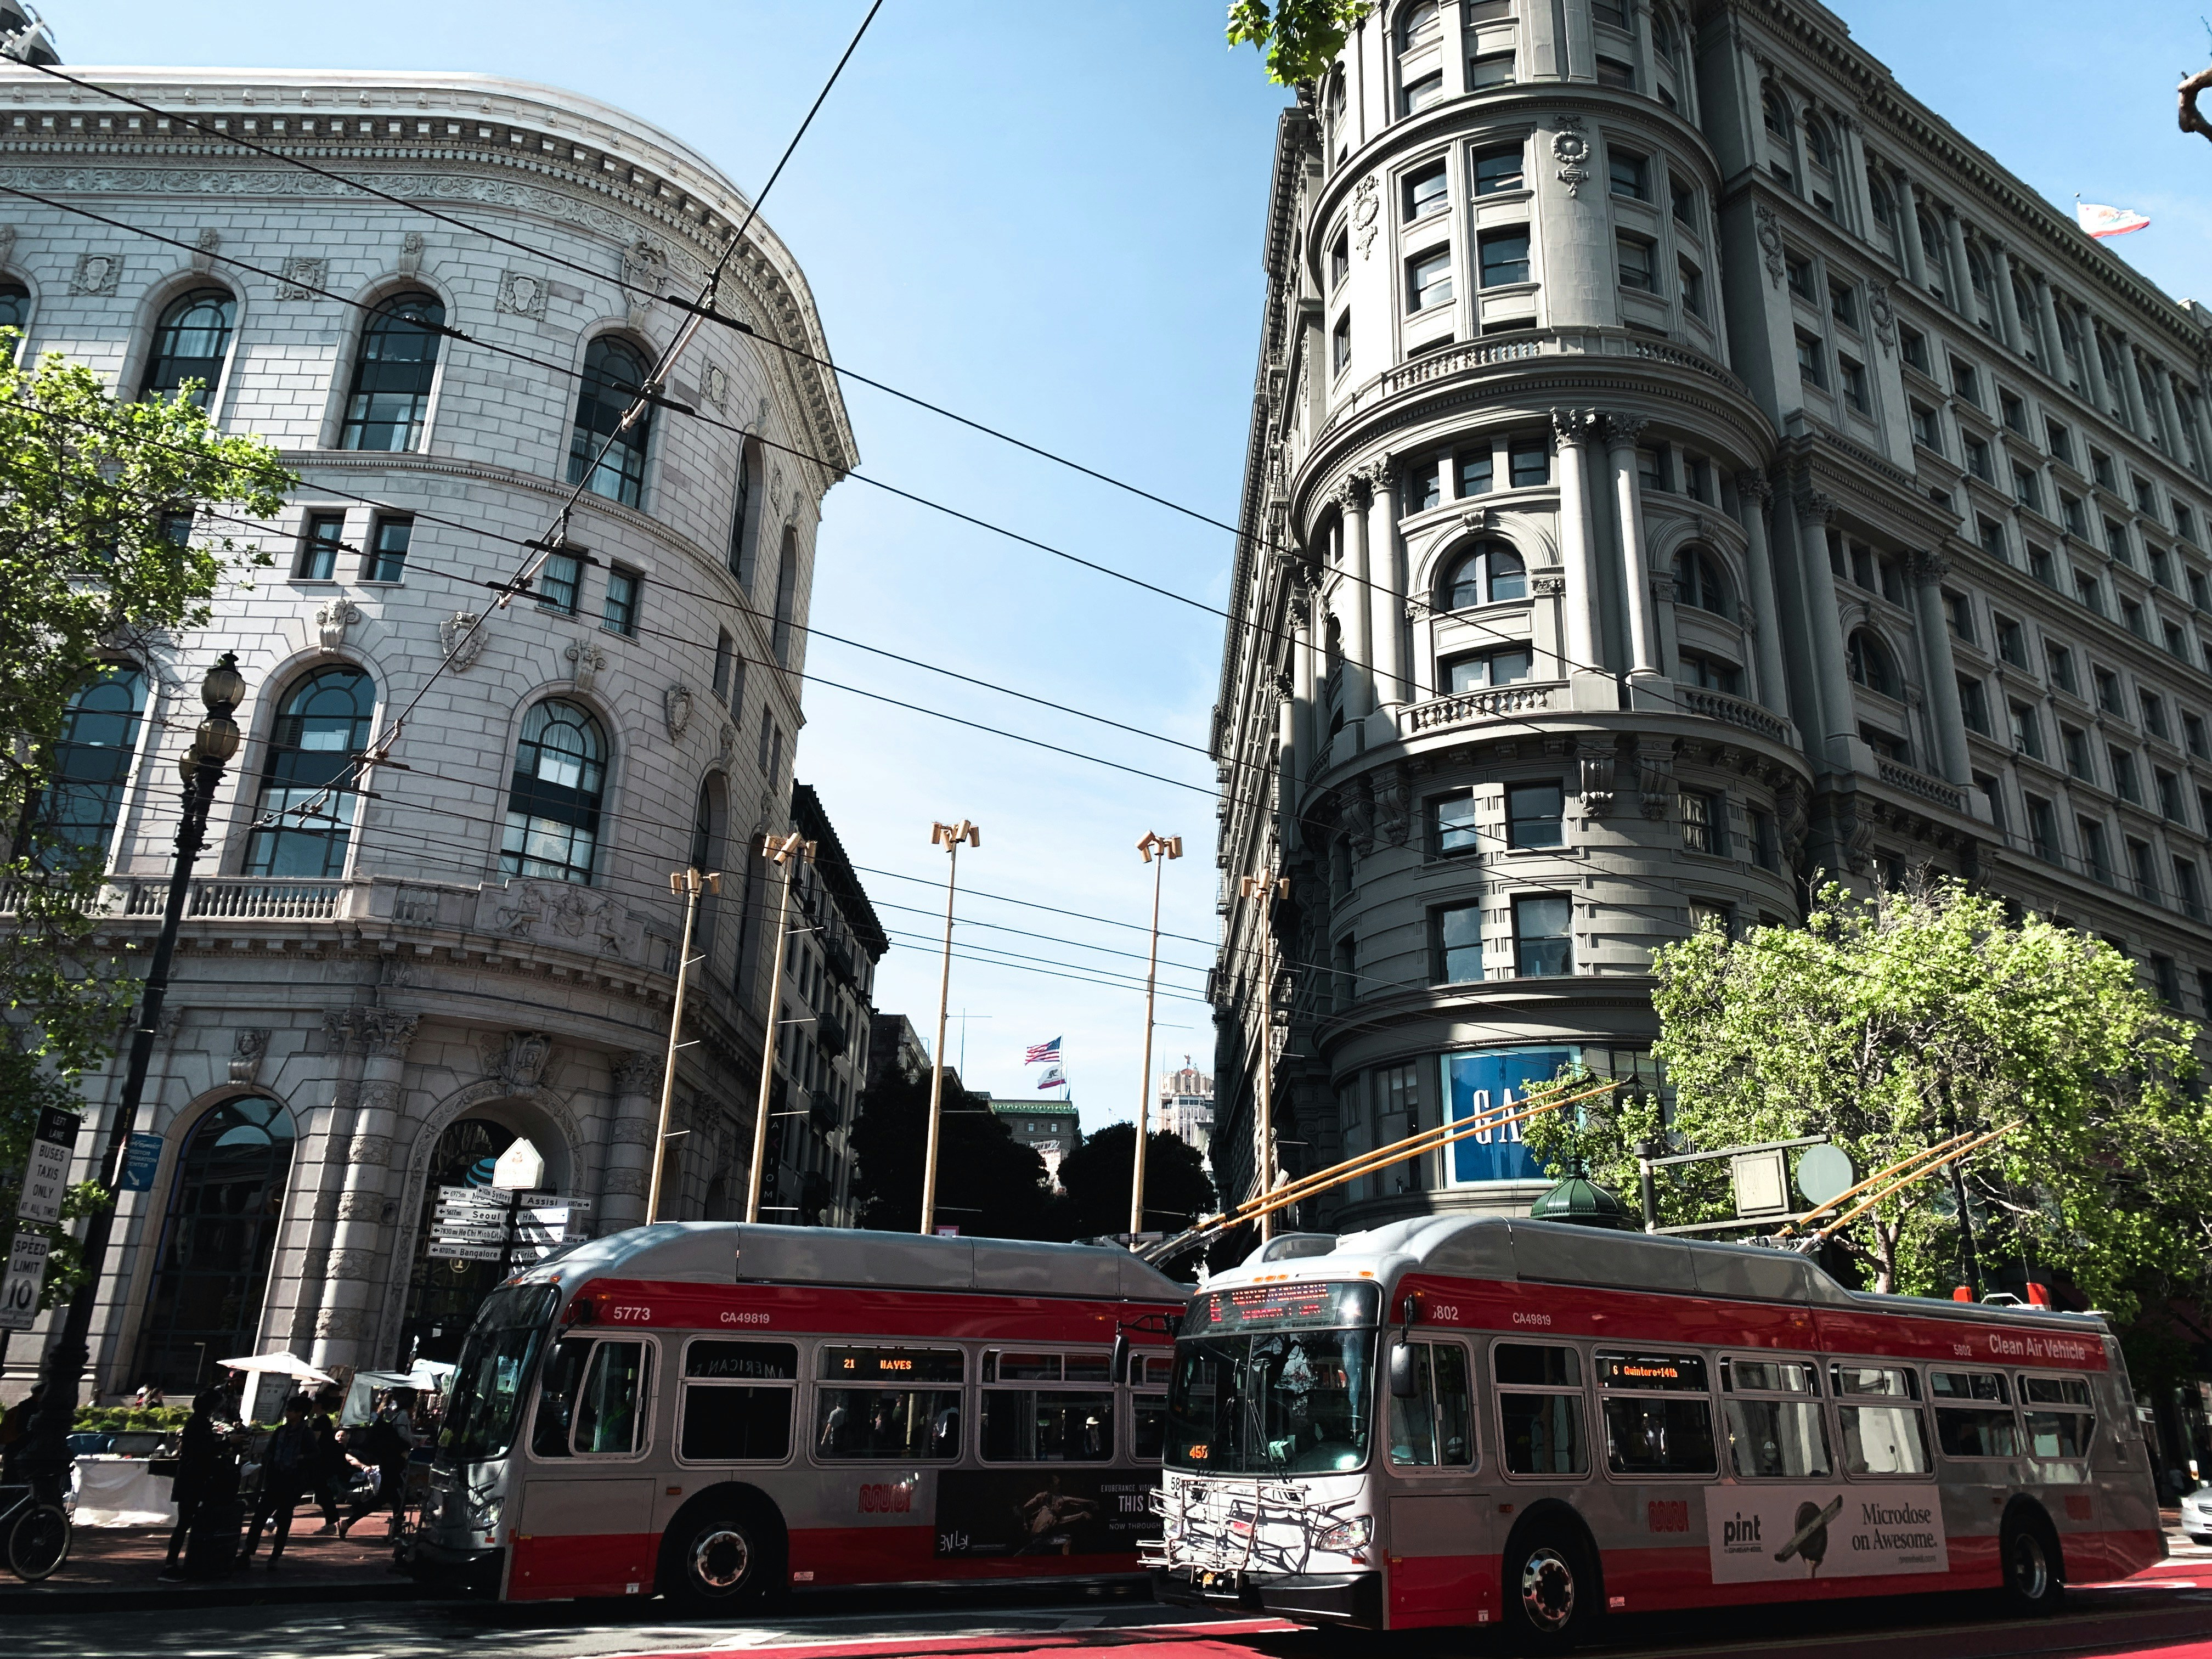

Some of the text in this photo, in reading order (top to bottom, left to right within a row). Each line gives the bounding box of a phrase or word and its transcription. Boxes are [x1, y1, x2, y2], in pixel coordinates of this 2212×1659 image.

[52, 1114, 67, 1127] LEFT
[1473, 1088, 1534, 1144] GA
[49, 1128, 65, 1141] LANE
[38, 1145, 65, 1162] BUSES
[764, 1121, 780, 1198] AXIOM
[37, 1164, 59, 1181] TAXIS
[32, 1184, 54, 1199] ONLY
[492, 1190, 511, 1203] Sydney
[527, 1197, 558, 1206] Assisi
[472, 1211, 500, 1220] Seoul
[477, 1230, 490, 1238] Minh
[14, 1240, 47, 1256] SPEED
[460, 1249, 498, 1259] Bangalore
[13, 1260, 40, 1274] LIMIT
[9, 1278, 32, 1310] 10
[613, 1306, 650, 1321] 5773
[720, 1312, 770, 1324] CA49819
[1513, 1312, 1551, 1325] CA49819
[1953, 1344, 1972, 1357] 5802
[1989, 1334, 2086, 1361] Clean Air Vehicle
[844, 1359, 912, 1370] 21 HAYES
[1613, 1365, 1618, 1375] 6
[1101, 1484, 1135, 1492] EXUBERANCE
[1118, 1495, 1144, 1513] THIS
[1862, 1503, 1931, 1526] Microdose
[1724, 1511, 1761, 1547] pint
[1852, 1529, 1938, 1551] on Awesome.
